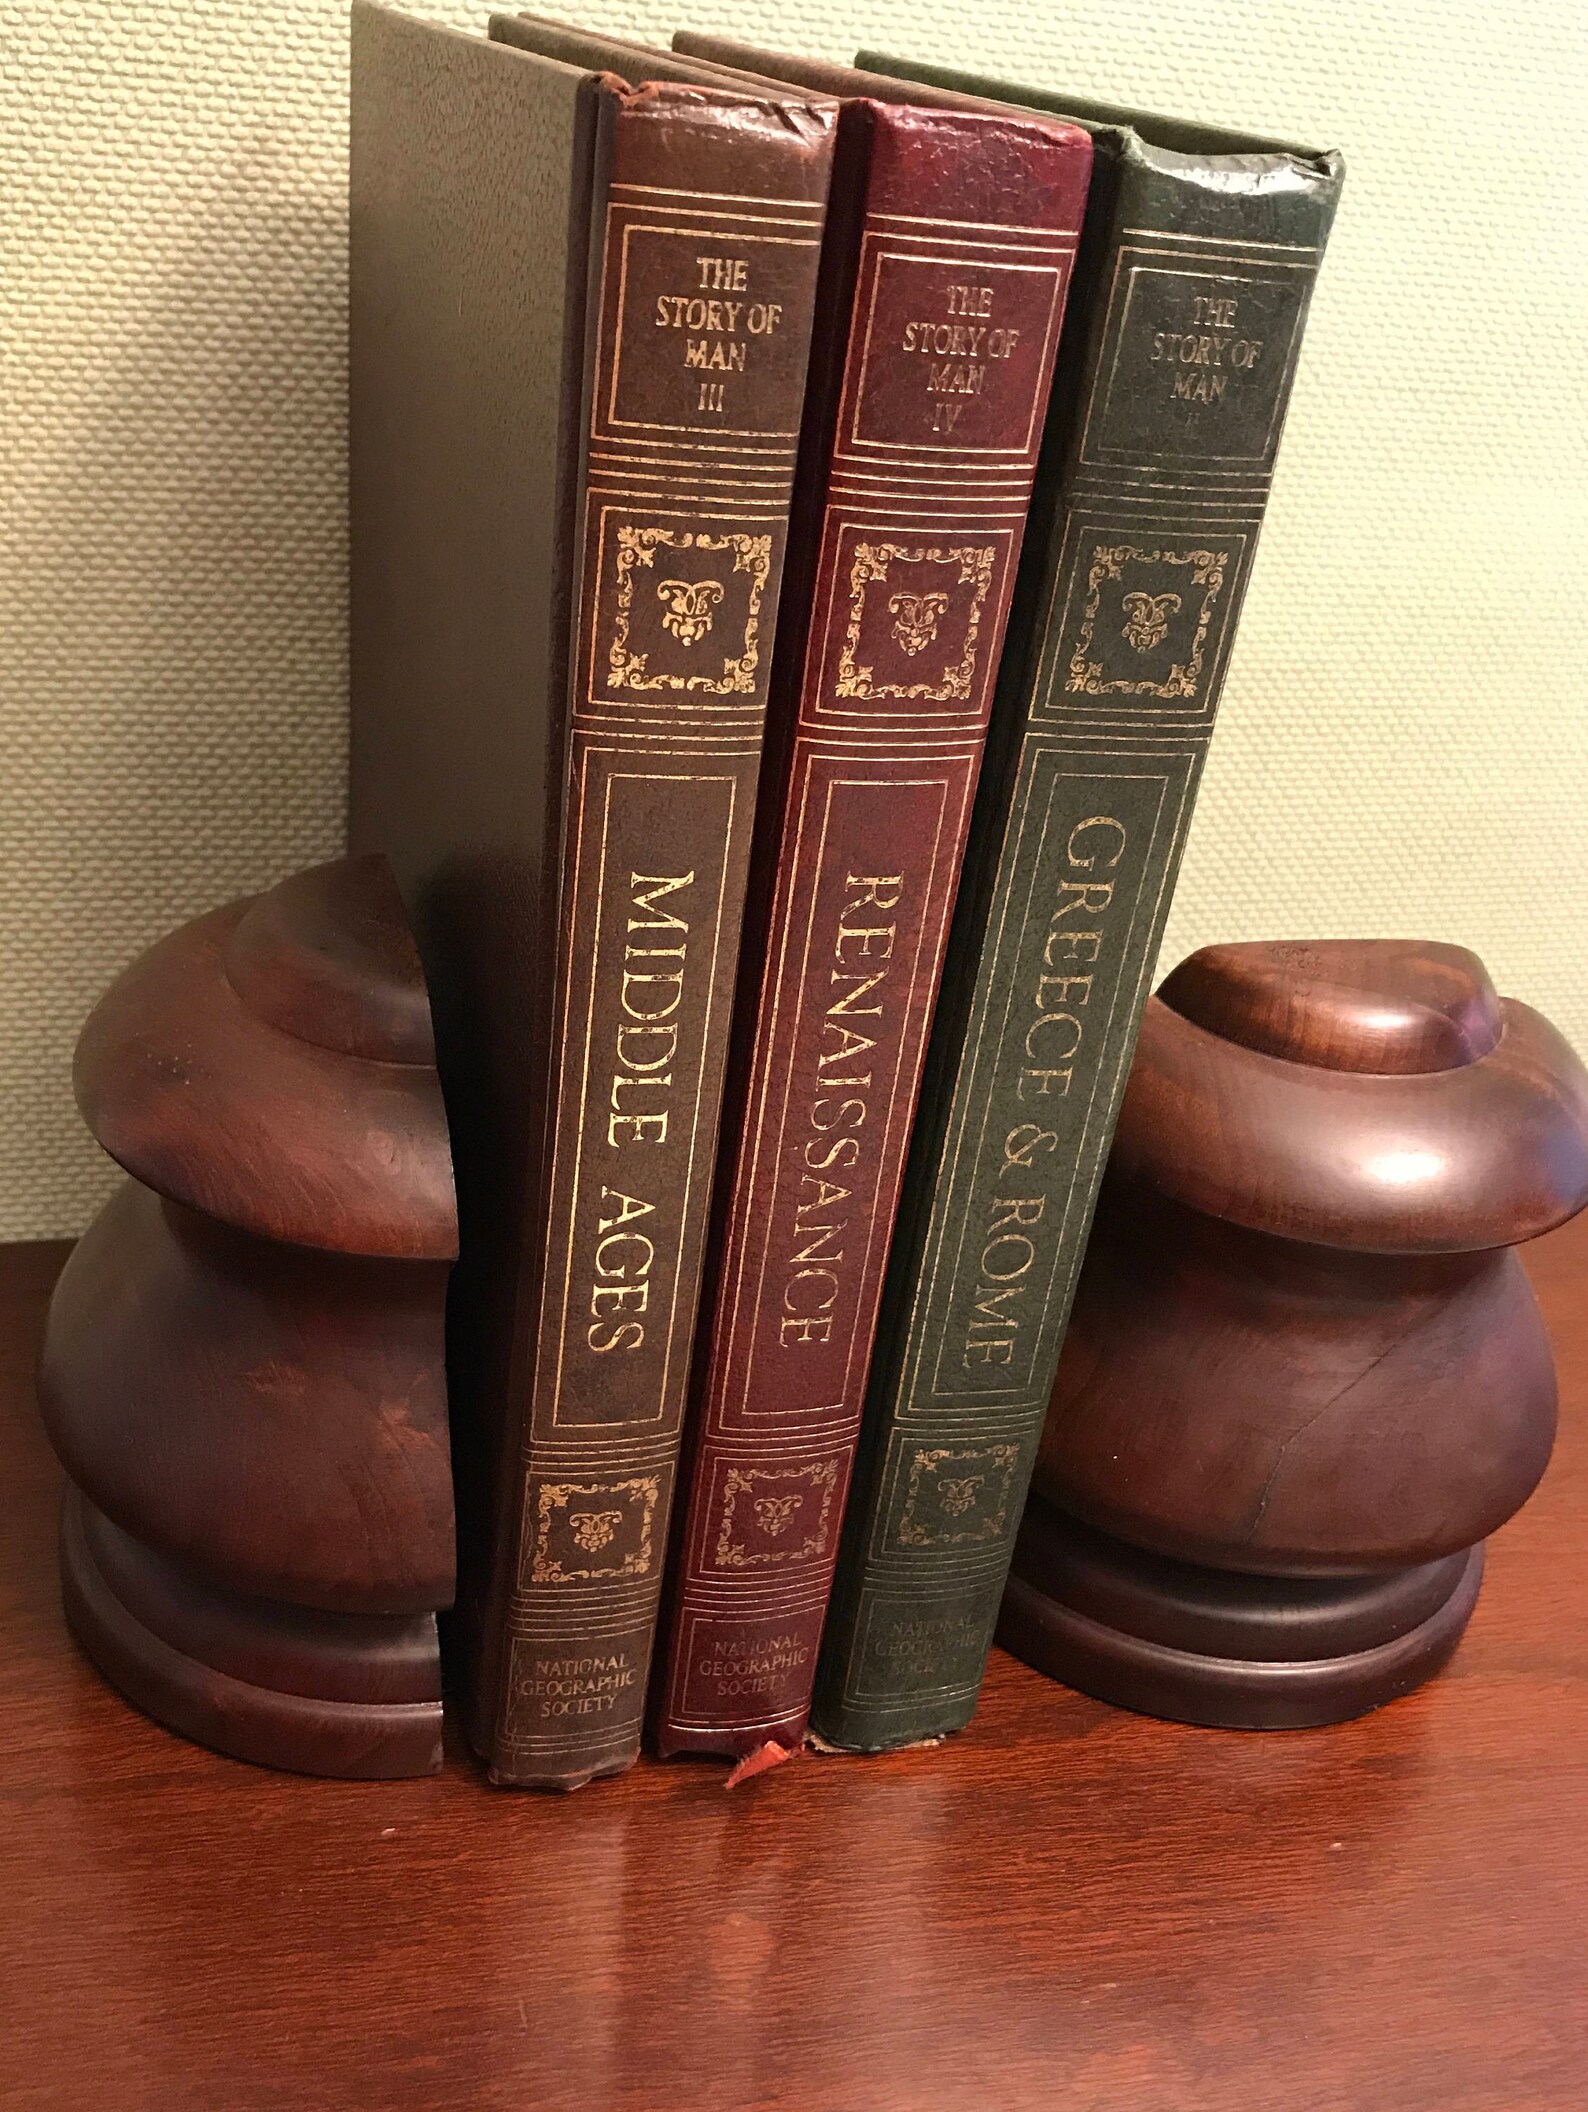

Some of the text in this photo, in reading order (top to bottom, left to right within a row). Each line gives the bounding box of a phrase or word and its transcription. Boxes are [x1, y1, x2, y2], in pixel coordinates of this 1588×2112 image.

[696, 257, 749, 291] THE
[655, 296, 782, 334] STORY OF
[946, 285, 994, 317] THE
[1193, 296, 1239, 328] THE
[684, 338, 747, 371] MAN
[902, 322, 1020, 359] STORY OF
[1151, 332, 1264, 369] STORY OF
[926, 362, 986, 395] MAN
[1169, 371, 1229, 402] MAN
[698, 384, 724, 412] III
[932, 403, 962, 433] IV
[961, 815, 1127, 1368] GREECE & ROME
[587, 870, 695, 1353] MIDDLE AGES
[779, 869, 905, 1348] RENAISSANCE
[535, 1653, 630, 1677] NATIONAL
[699, 1646, 810, 1676] GEOGRAPHIC
[521, 1668, 638, 1696] GEOGRAPHIC
[716, 1672, 791, 1696] SOCIETY
[540, 1693, 618, 1718] SOCIETY
